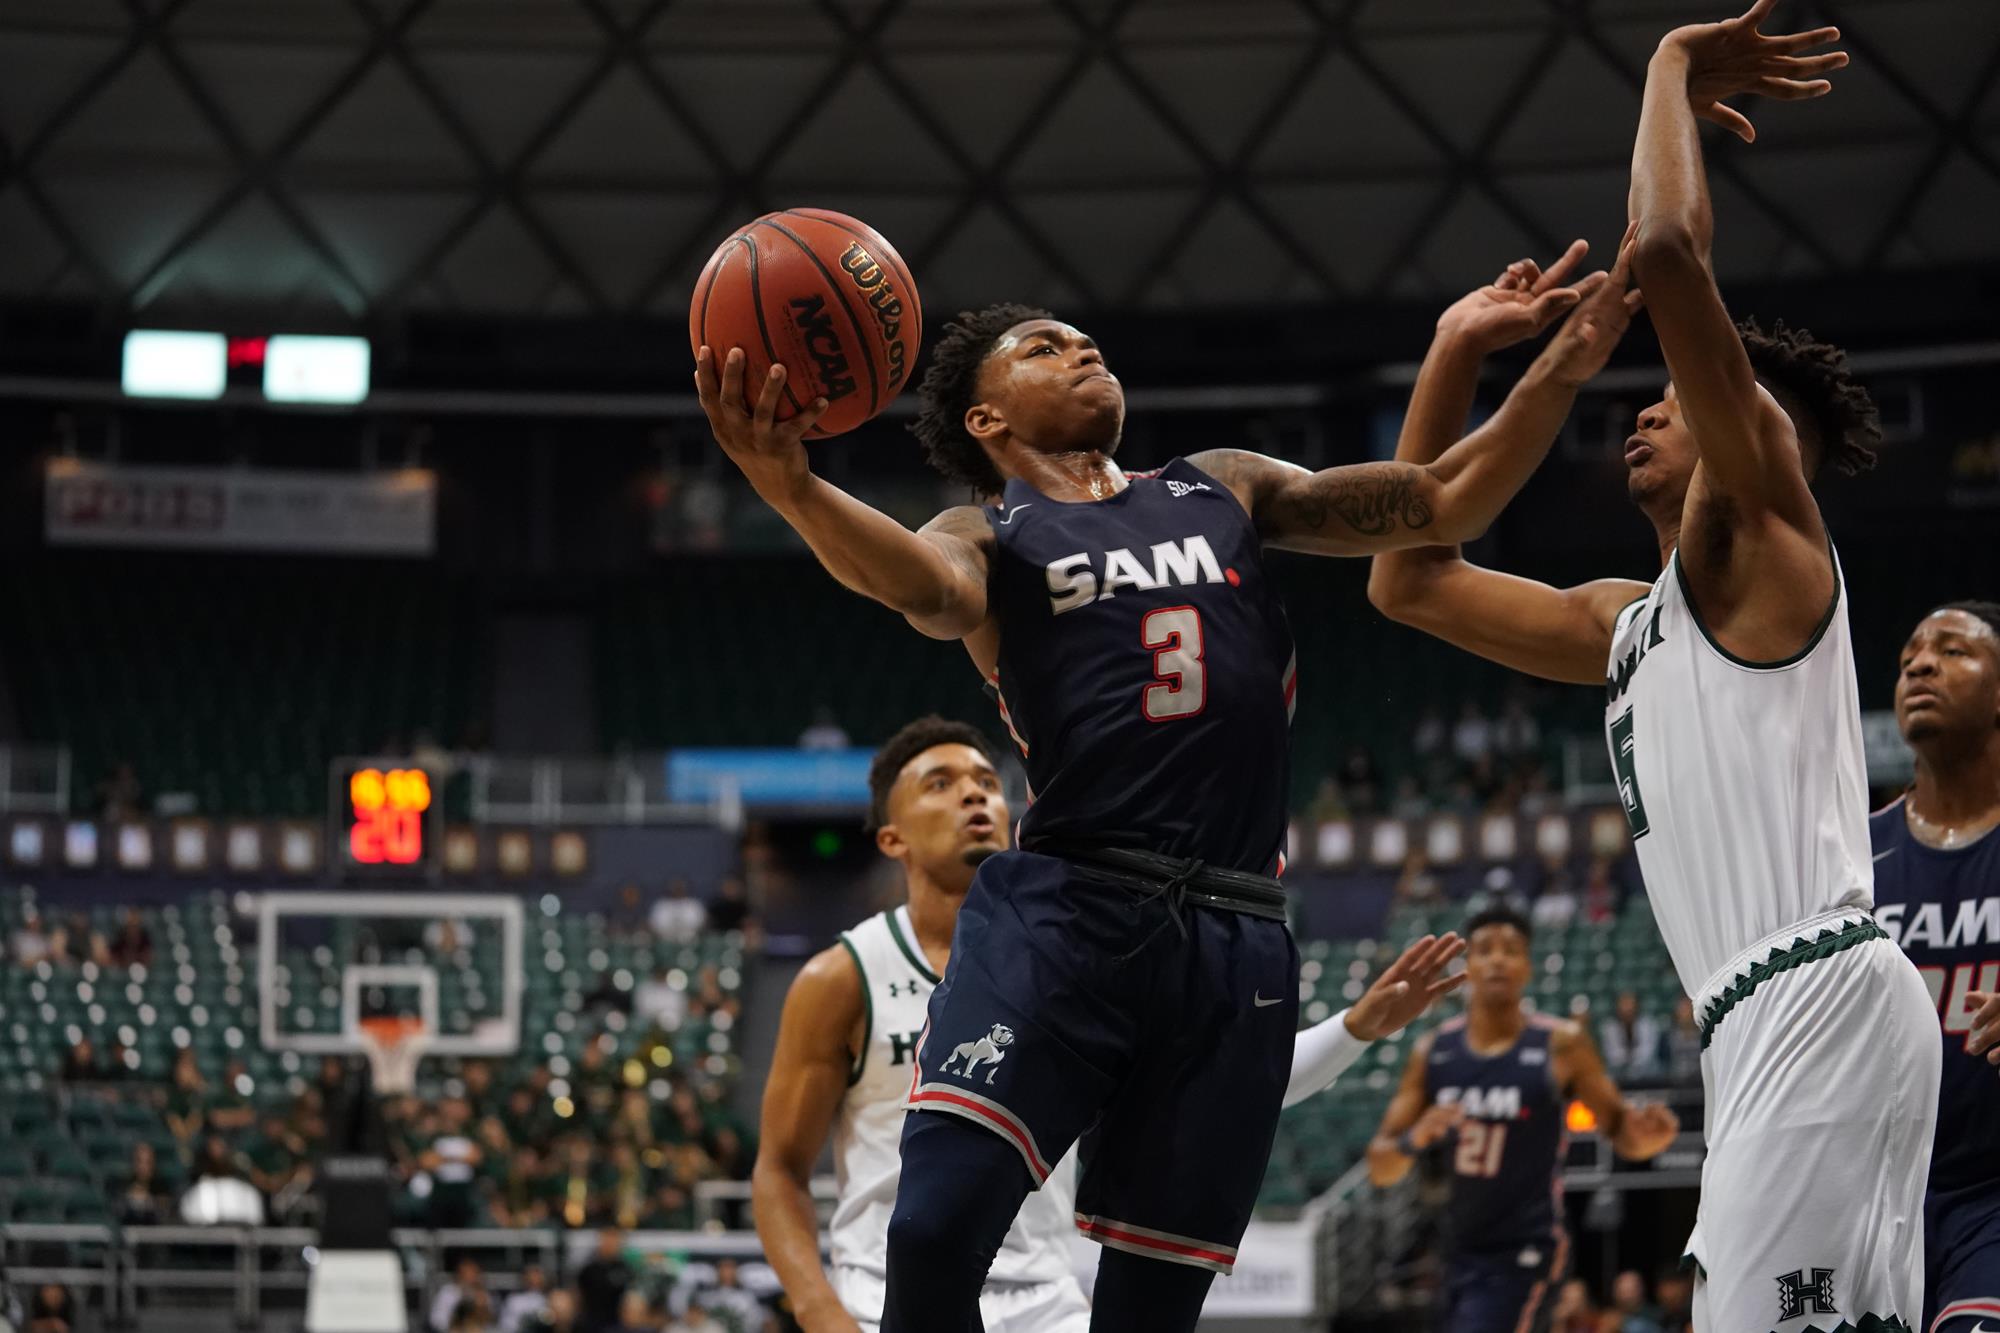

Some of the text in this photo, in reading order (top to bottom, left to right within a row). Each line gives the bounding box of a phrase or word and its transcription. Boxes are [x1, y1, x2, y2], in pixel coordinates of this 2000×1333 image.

[790, 294, 857, 401] NCAA
[839, 240, 904, 391] Wilson
[1140, 604, 1207, 722] 3
[1456, 1120, 1507, 1178] 21
[1775, 1267, 1838, 1323] H
